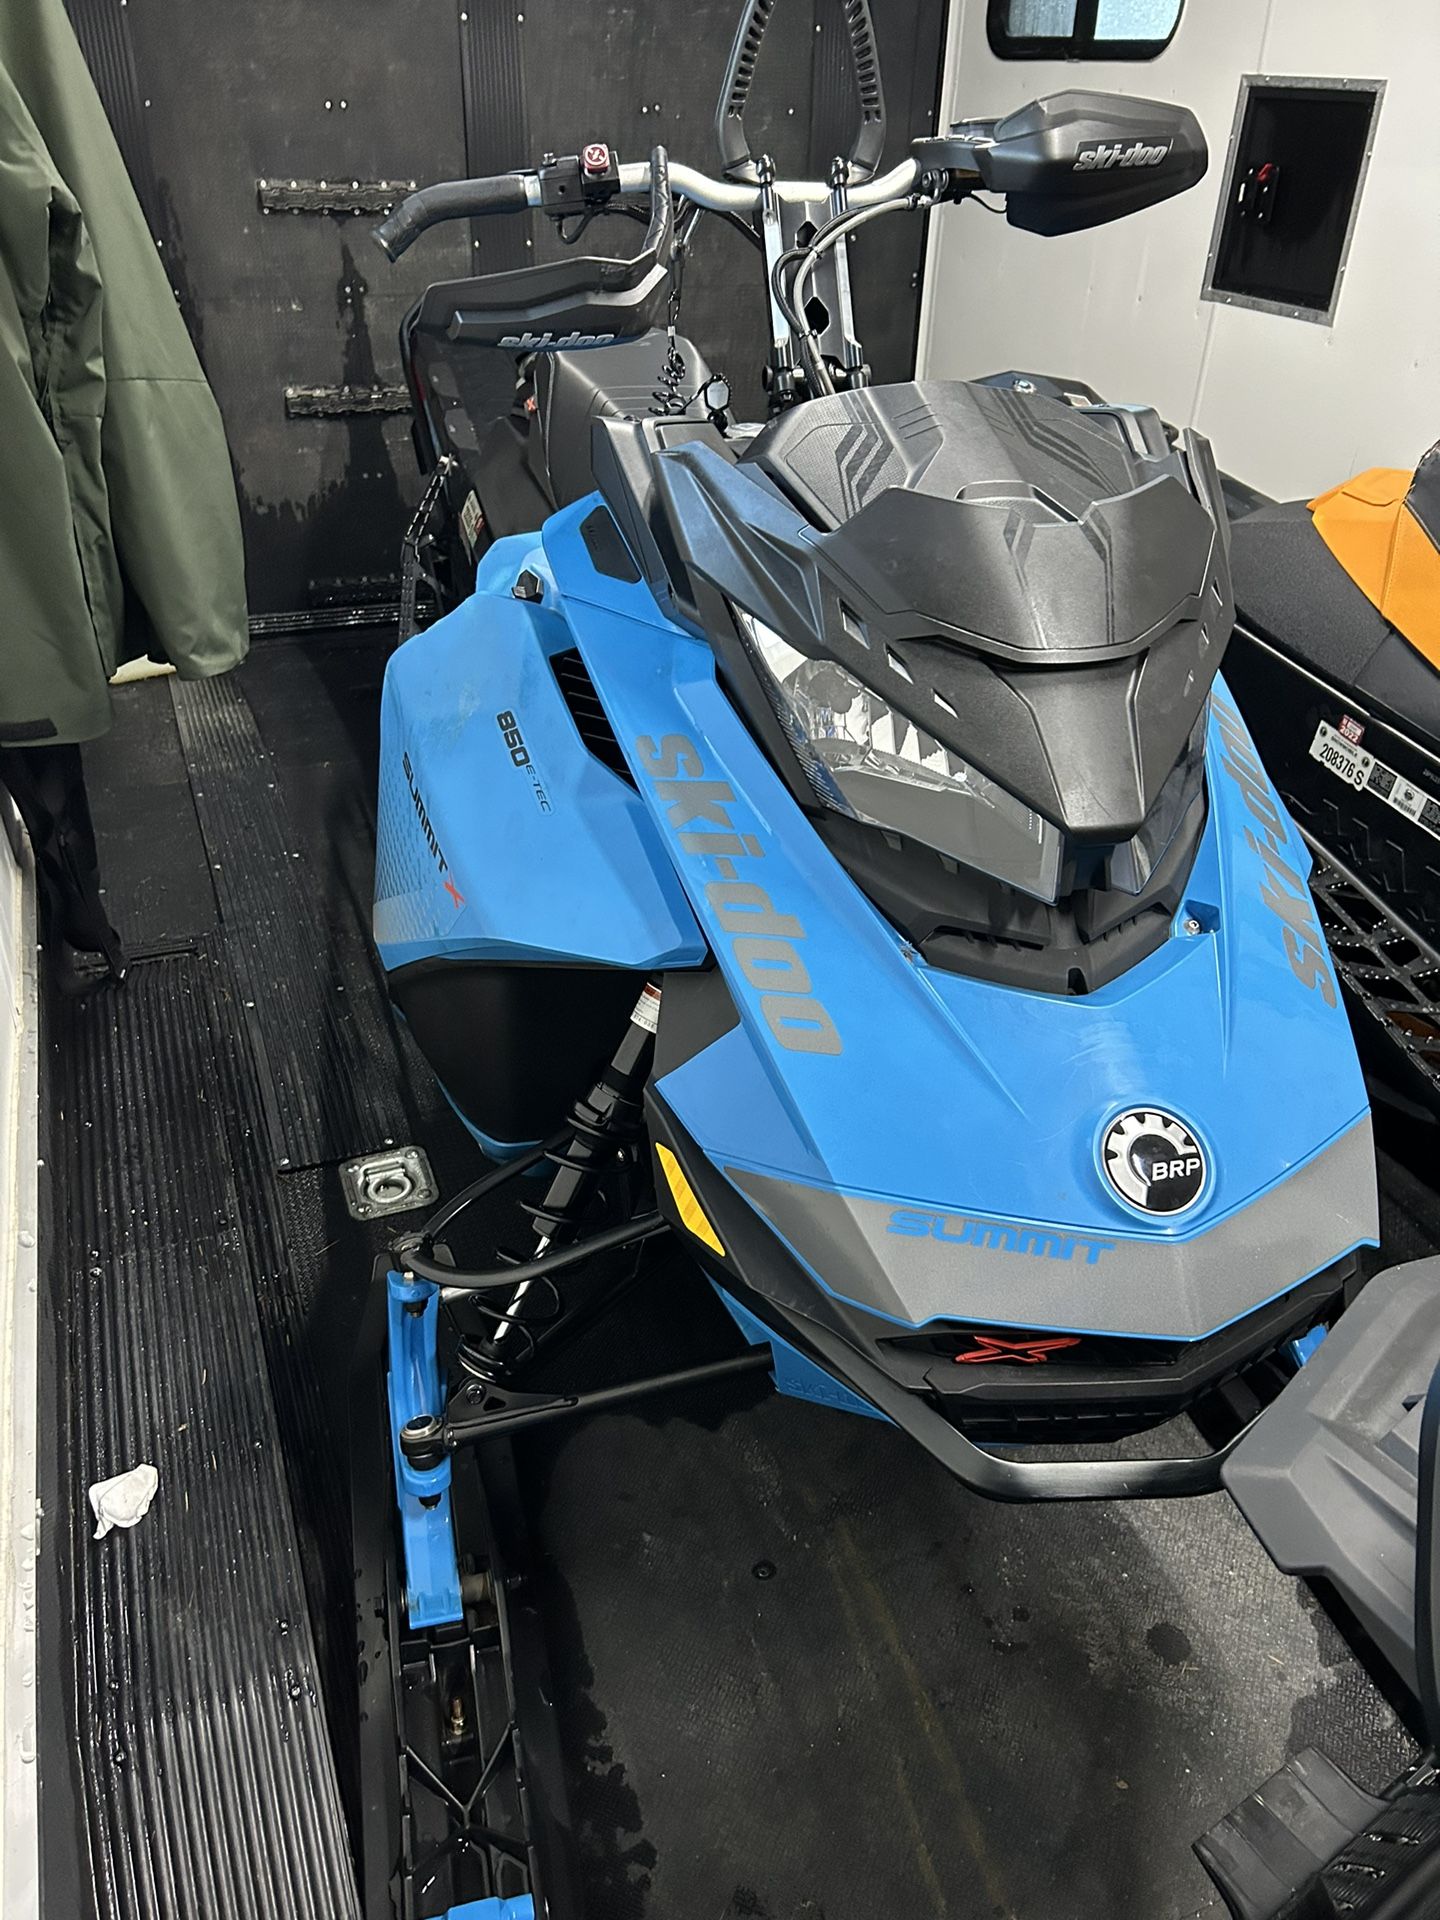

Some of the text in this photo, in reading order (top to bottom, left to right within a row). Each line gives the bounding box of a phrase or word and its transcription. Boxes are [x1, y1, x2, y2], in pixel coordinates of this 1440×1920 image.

[496, 710, 531, 768] 850
[1319, 743, 1356, 778] 208376
[402, 751, 448, 874] SUMMIT
[1151, 1157, 1201, 1182] BRP
[886, 1209, 1116, 1266] SUMMIT
